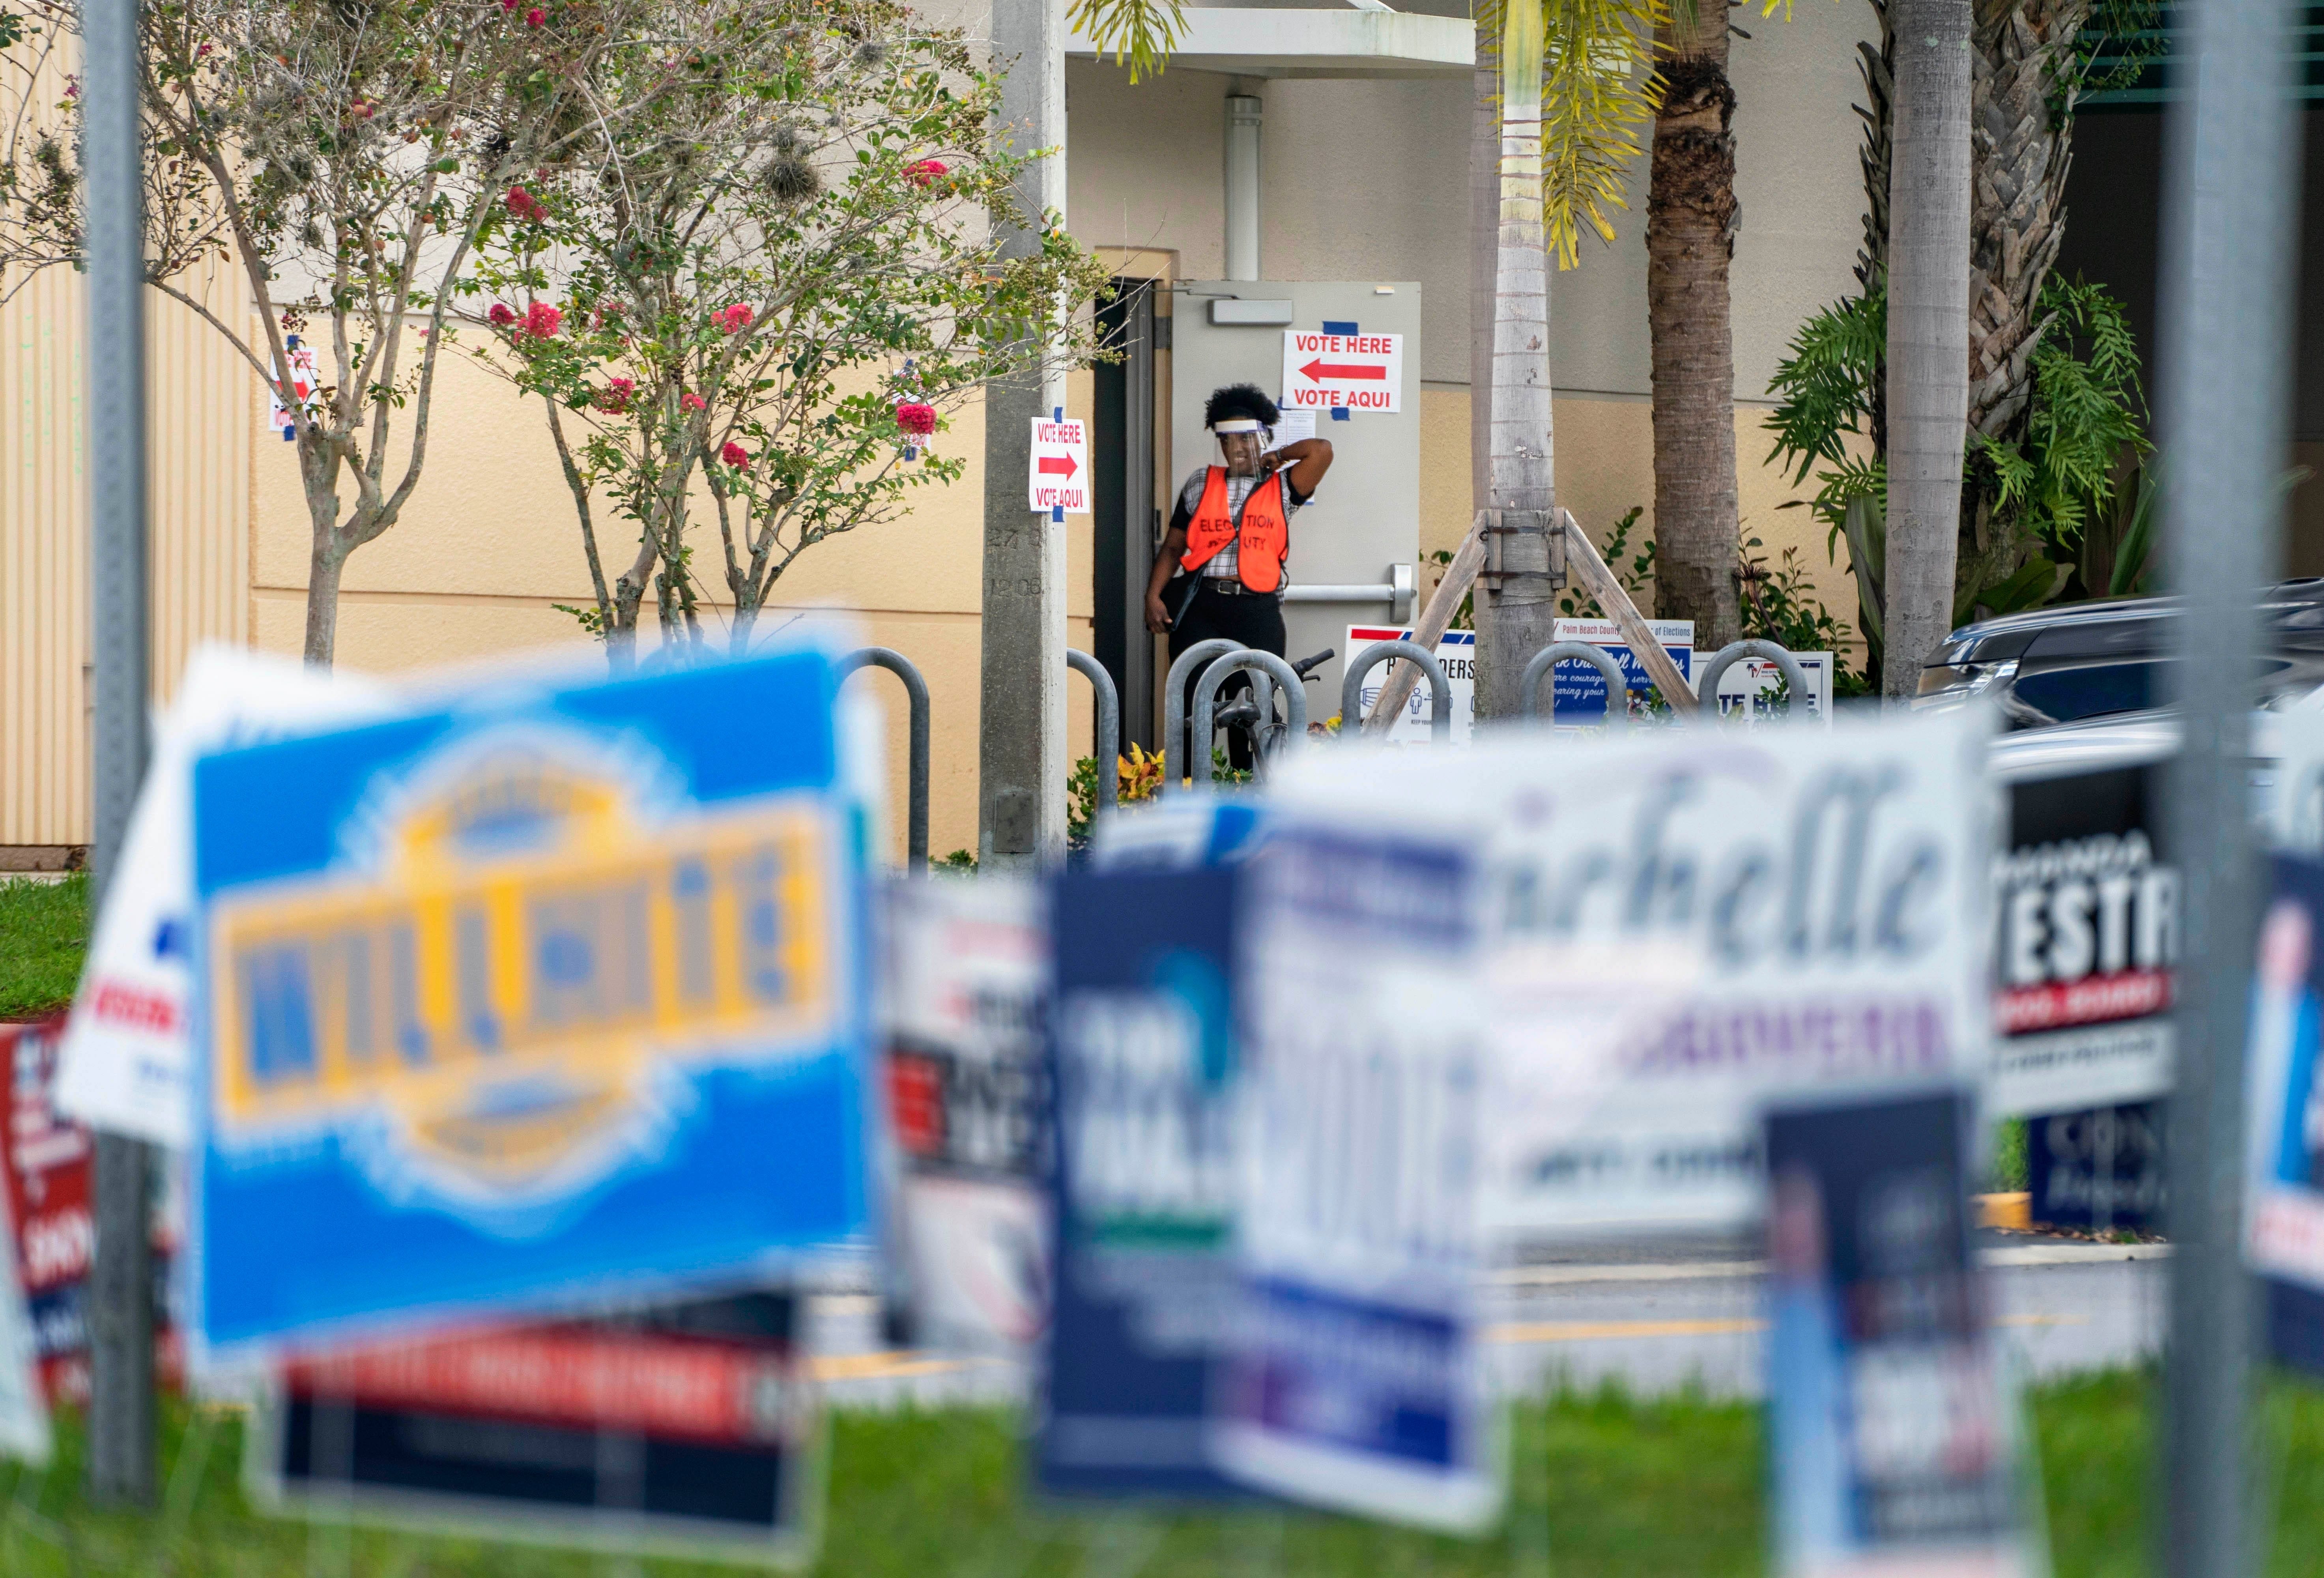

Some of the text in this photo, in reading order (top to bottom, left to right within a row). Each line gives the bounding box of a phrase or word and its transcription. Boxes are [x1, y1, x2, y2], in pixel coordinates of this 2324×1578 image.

[1296, 335, 1392, 353] VOTE HERE
[1294, 389, 1390, 408] VOTE AQUI
[1038, 423, 1081, 443] VOTE HERE
[1036, 488, 1056, 507] VOTE
[1060, 489, 1083, 508] AQUI
[1563, 625, 1577, 634] Palm
[1580, 625, 1597, 634] Beach
[1664, 627, 1690, 636] Elections
[1554, 687, 1604, 699] earing your
